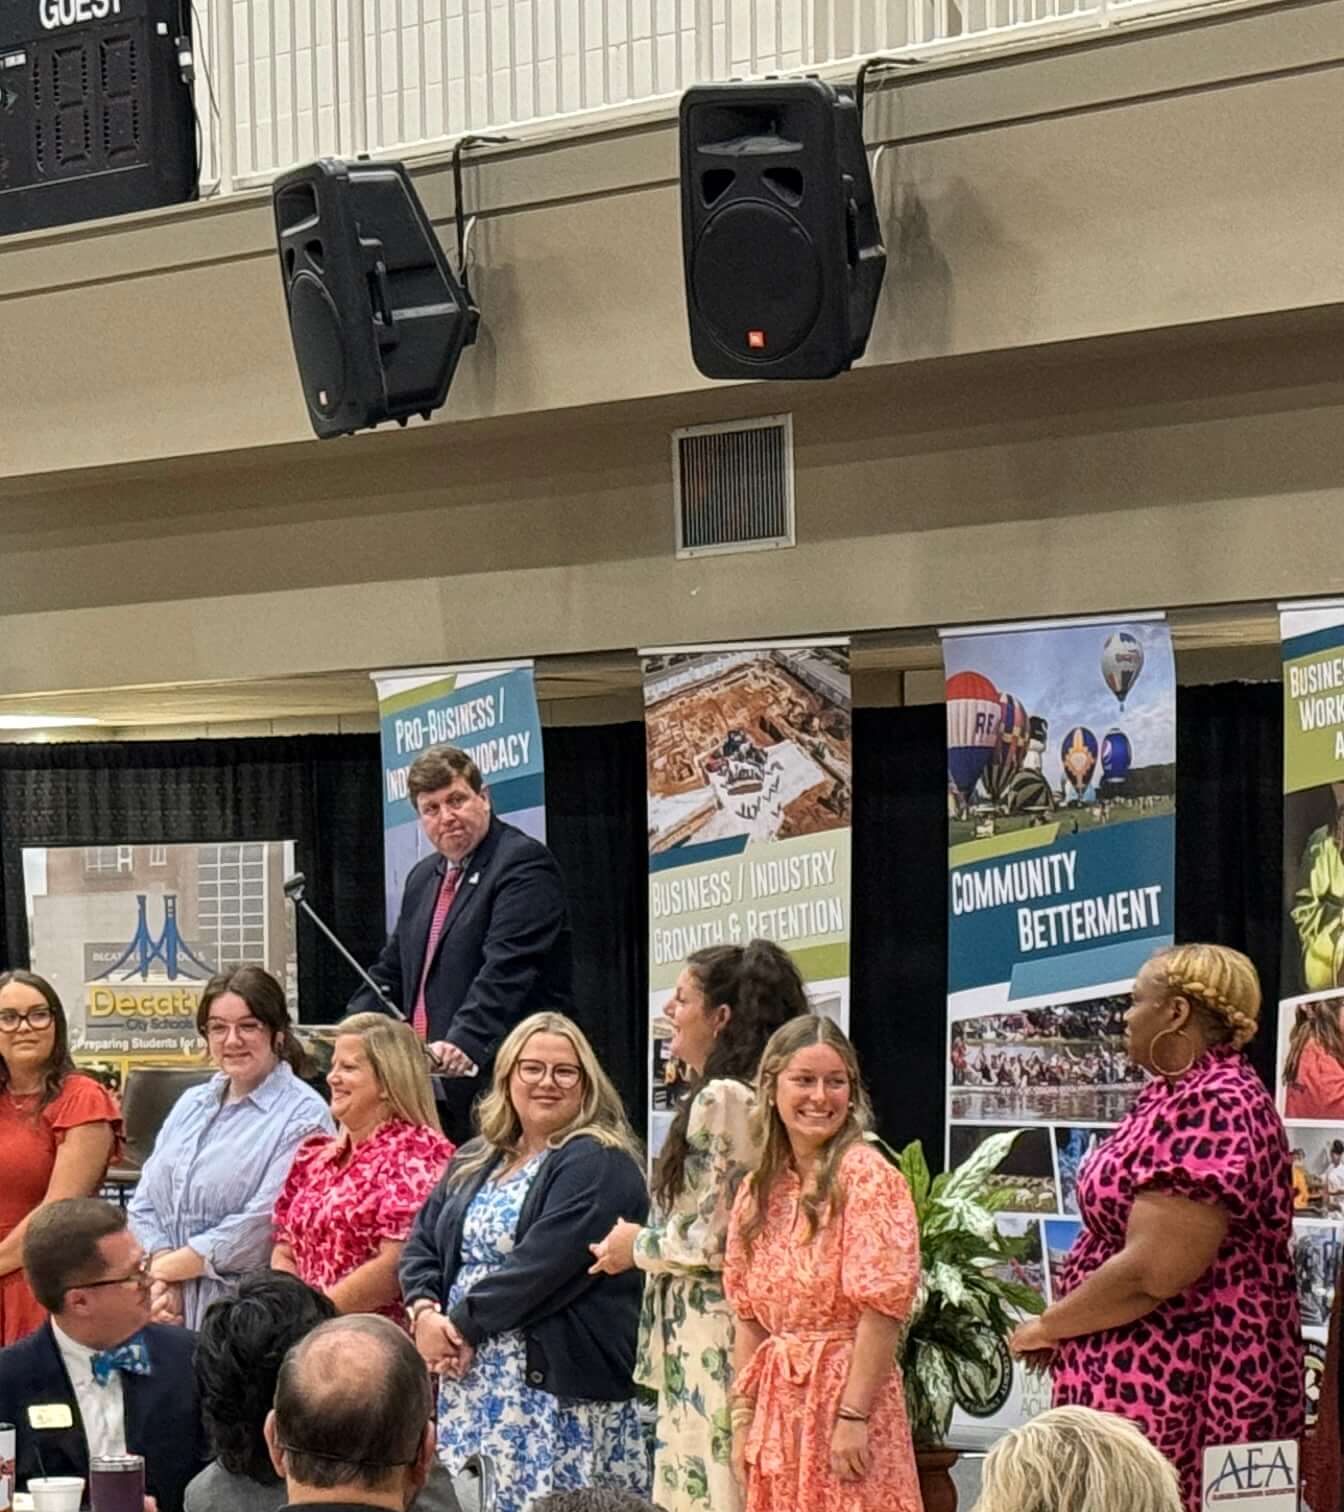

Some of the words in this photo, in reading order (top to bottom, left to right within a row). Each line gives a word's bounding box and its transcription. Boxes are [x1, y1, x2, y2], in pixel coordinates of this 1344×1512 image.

[395, 695, 495, 754] PRO-BUSINESS
[468, 731, 530, 775] VOCACY
[653, 870, 733, 918] BUSINESS
[750, 849, 837, 898] INDUSTRY
[952, 851, 1077, 915] COMMUNITY
[655, 919, 723, 965] GROWTH
[746, 897, 844, 942] RETENTION
[1018, 885, 1163, 953] BETTERMENT
[91, 986, 198, 1018] Decat
[126, 1019, 147, 1032] City
[151, 1018, 193, 1030] Schools
[132, 1036, 177, 1050] Students
[1208, 1446, 1294, 1490] AEA
